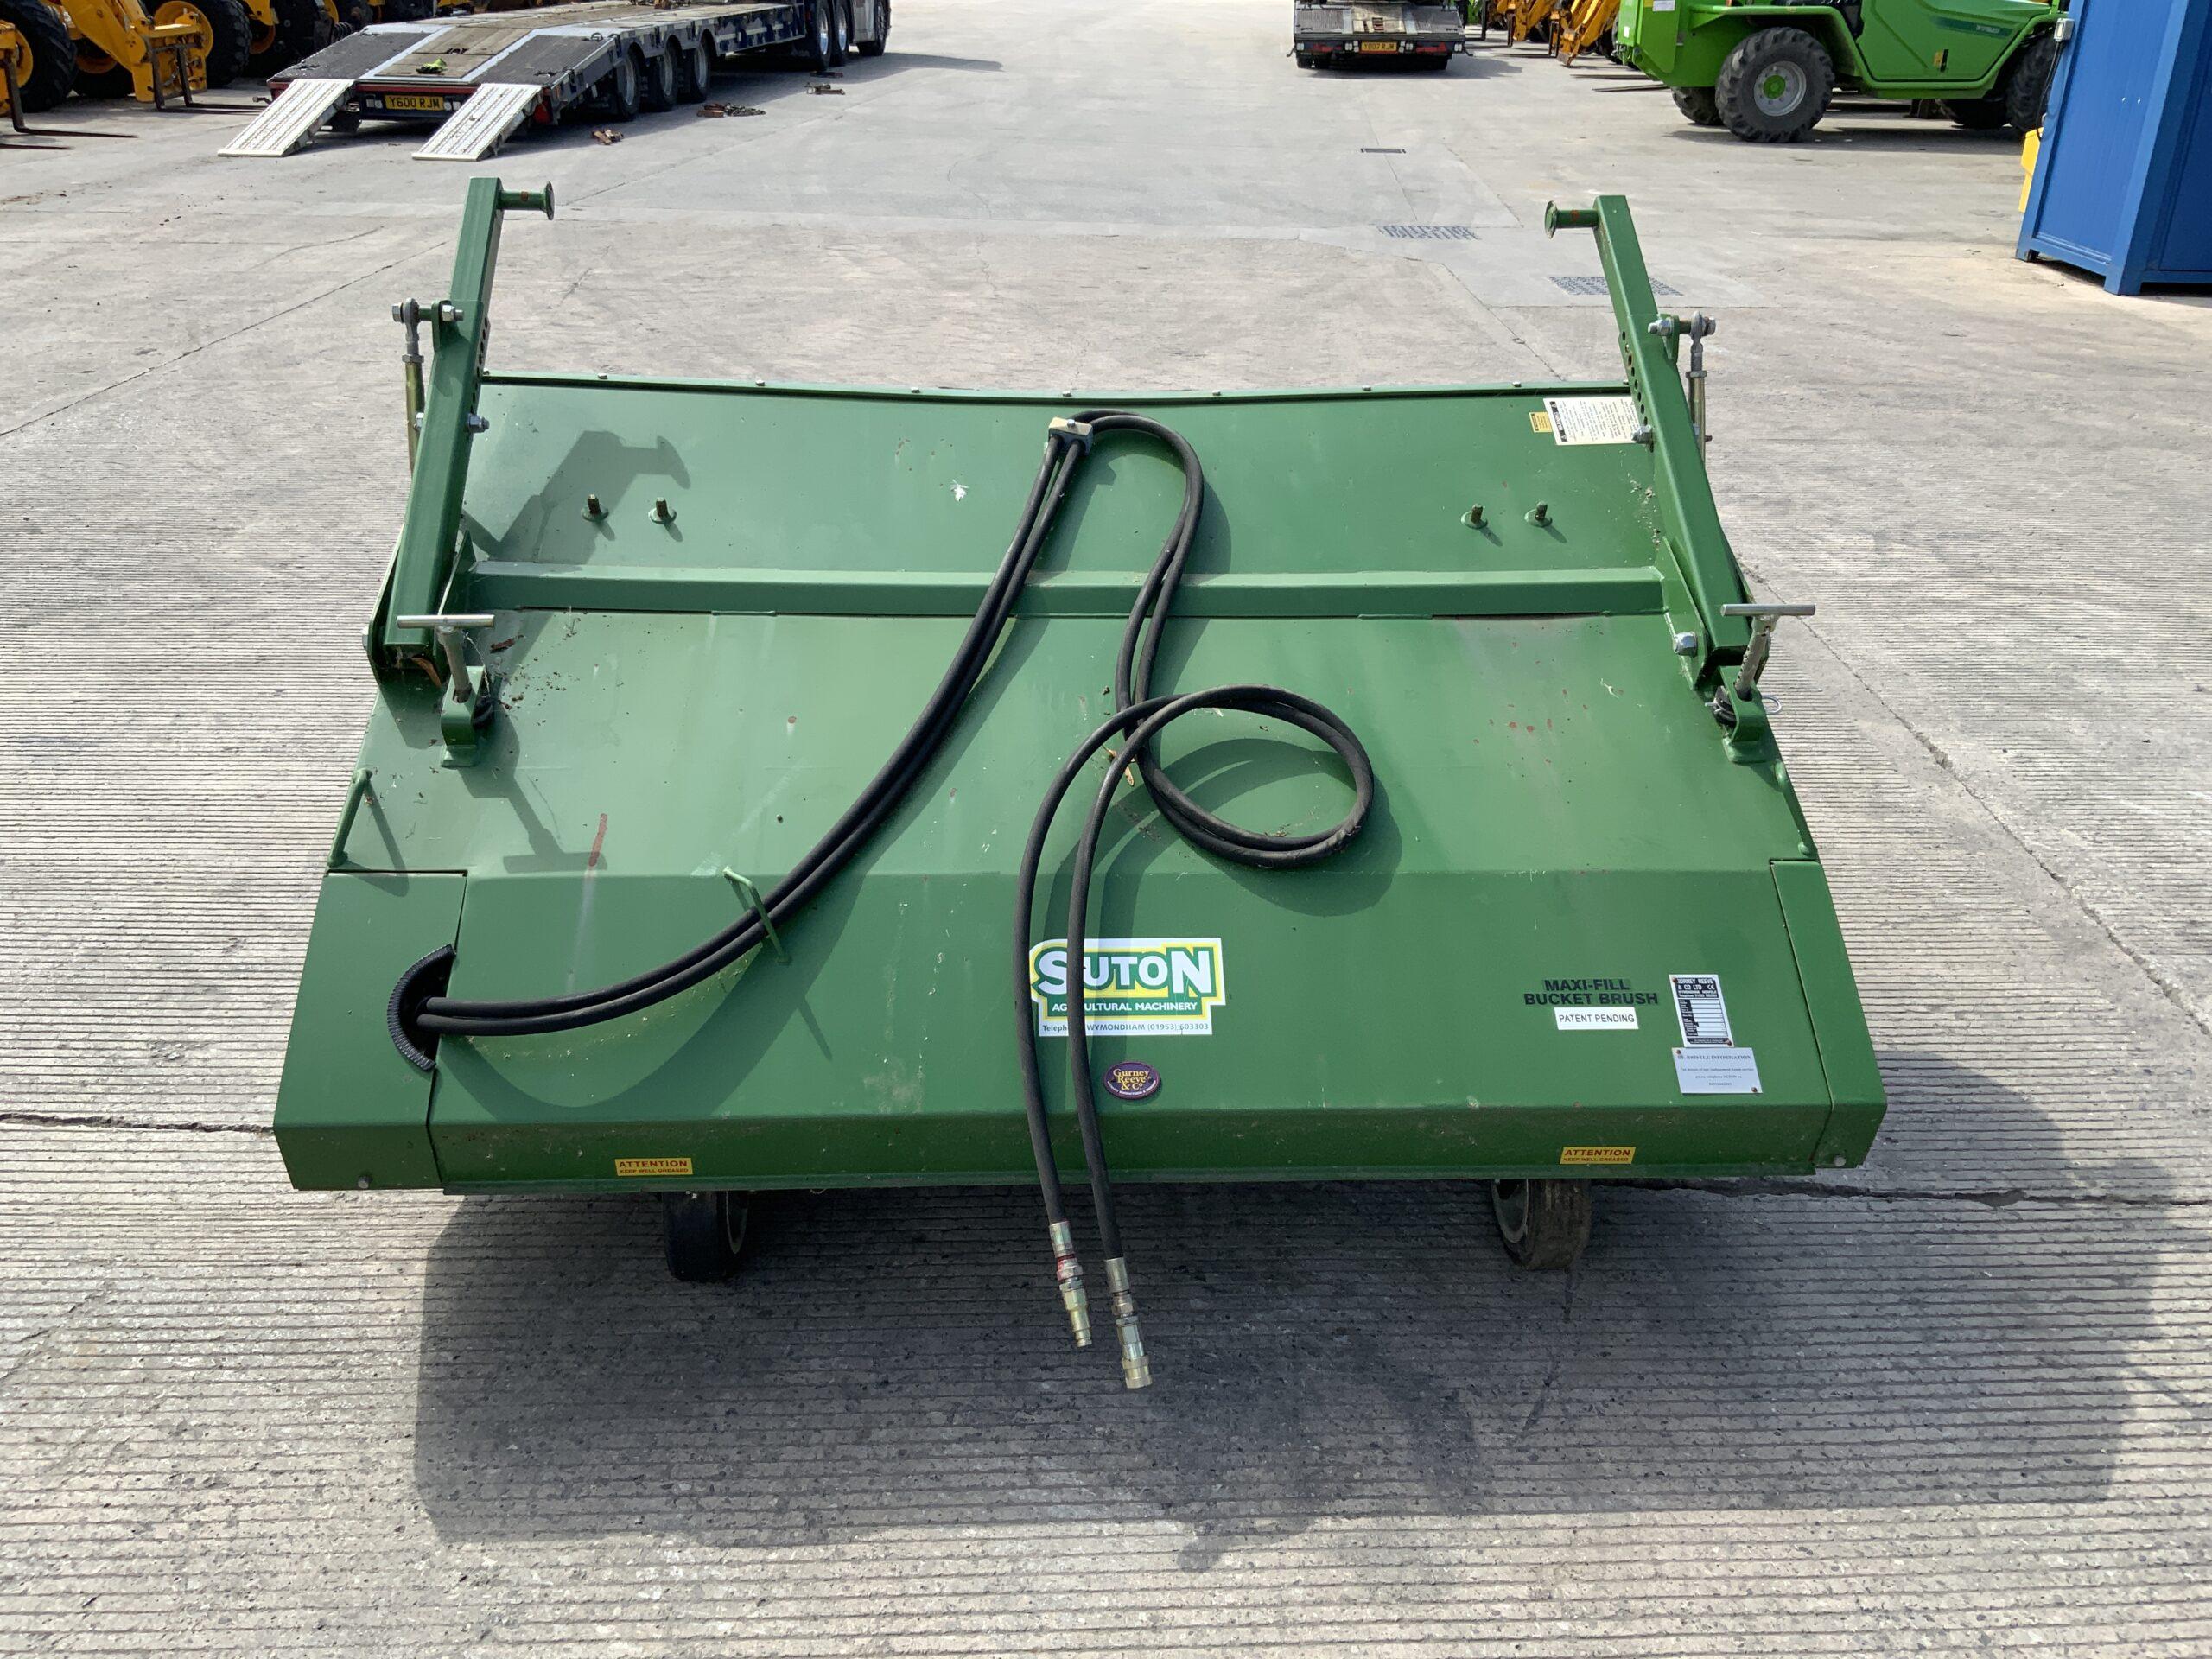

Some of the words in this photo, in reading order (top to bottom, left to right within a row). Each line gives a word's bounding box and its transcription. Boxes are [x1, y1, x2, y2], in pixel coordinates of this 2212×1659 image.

[389, 97, 416, 108] Y600
[419, 97, 440, 109] RJM
[1038, 950, 1211, 995] SUTON
[1544, 979, 1630, 991] MAXI-FILL
[1524, 993, 1592, 1005] BUCKET
[1599, 993, 1658, 1005] BRUSH
[1052, 1002, 1132, 1012] AGULTURAL
[1135, 1001, 1198, 1011] MACHINERY
[1595, 1014, 1635, 1023] PENDING
[1042, 1024, 1068, 1033] Teleph
[1147, 1023, 1177, 1032] (01953)
[1179, 1022, 1209, 1031] 603303
[1113, 1068, 1150, 1078] Gurney
[1116, 1075, 1146, 1084] Reeve
[1121, 1081, 1130, 1090] &
